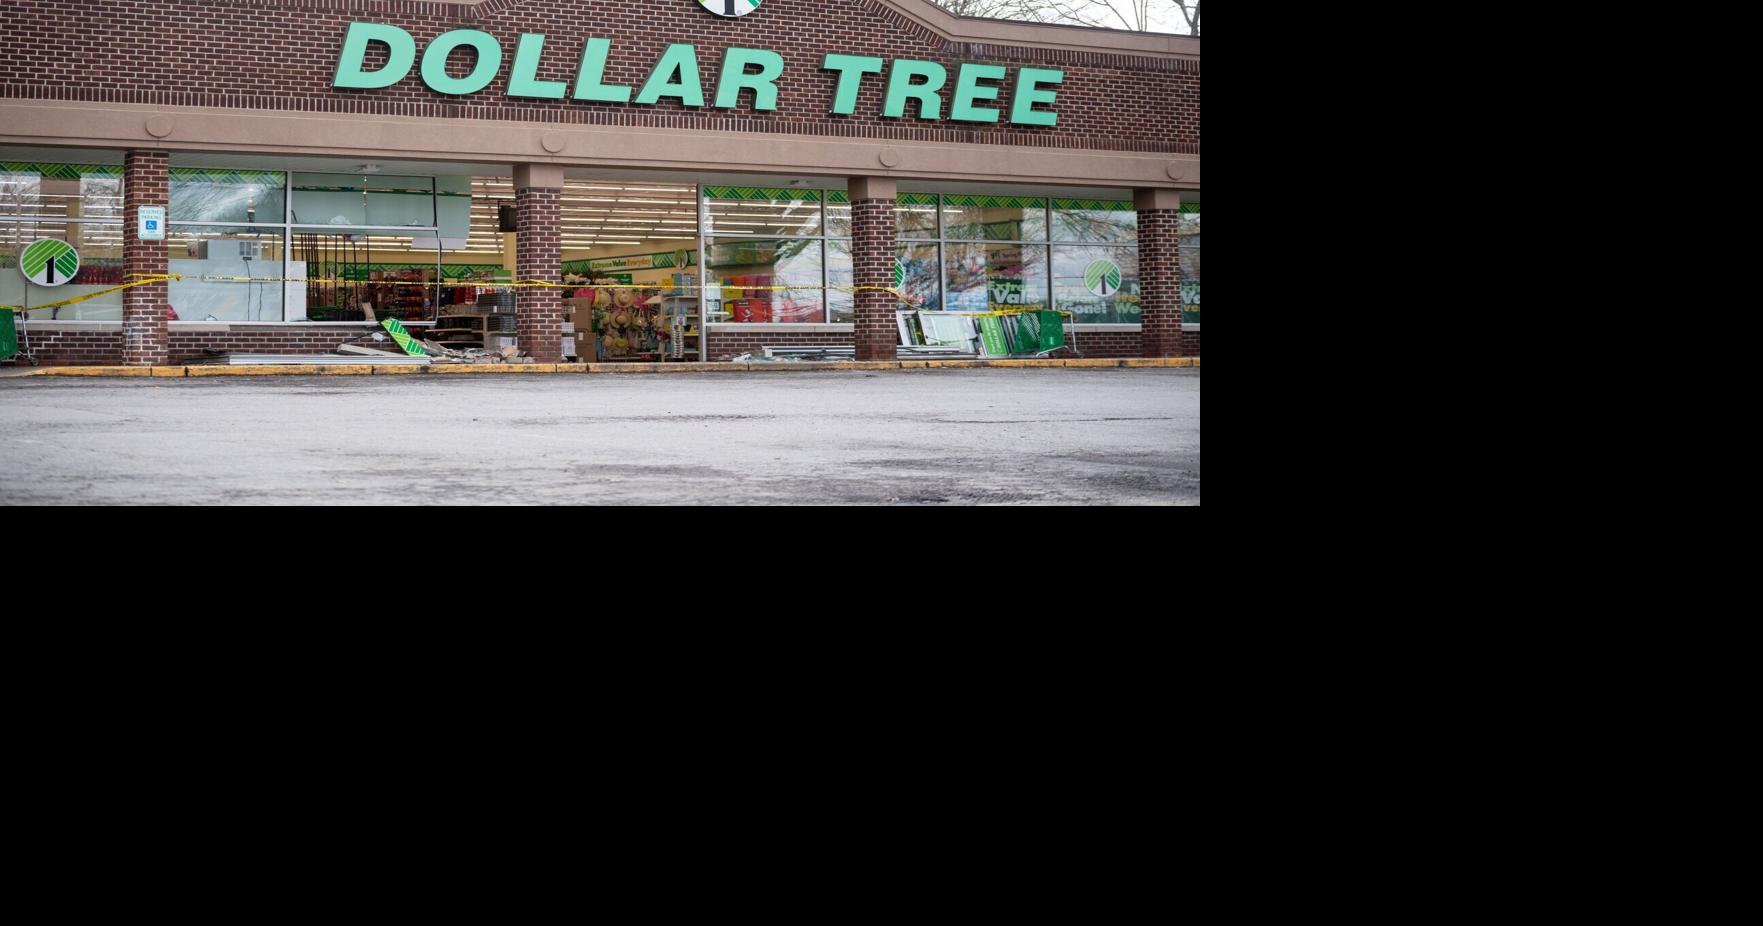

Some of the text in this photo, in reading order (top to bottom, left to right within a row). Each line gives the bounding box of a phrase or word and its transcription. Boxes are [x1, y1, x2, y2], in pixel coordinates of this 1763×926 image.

[331, 22, 1064, 126] DOLLAR TREE
[612, 259, 626, 267] Value
[626, 257, 652, 267] Everyday
